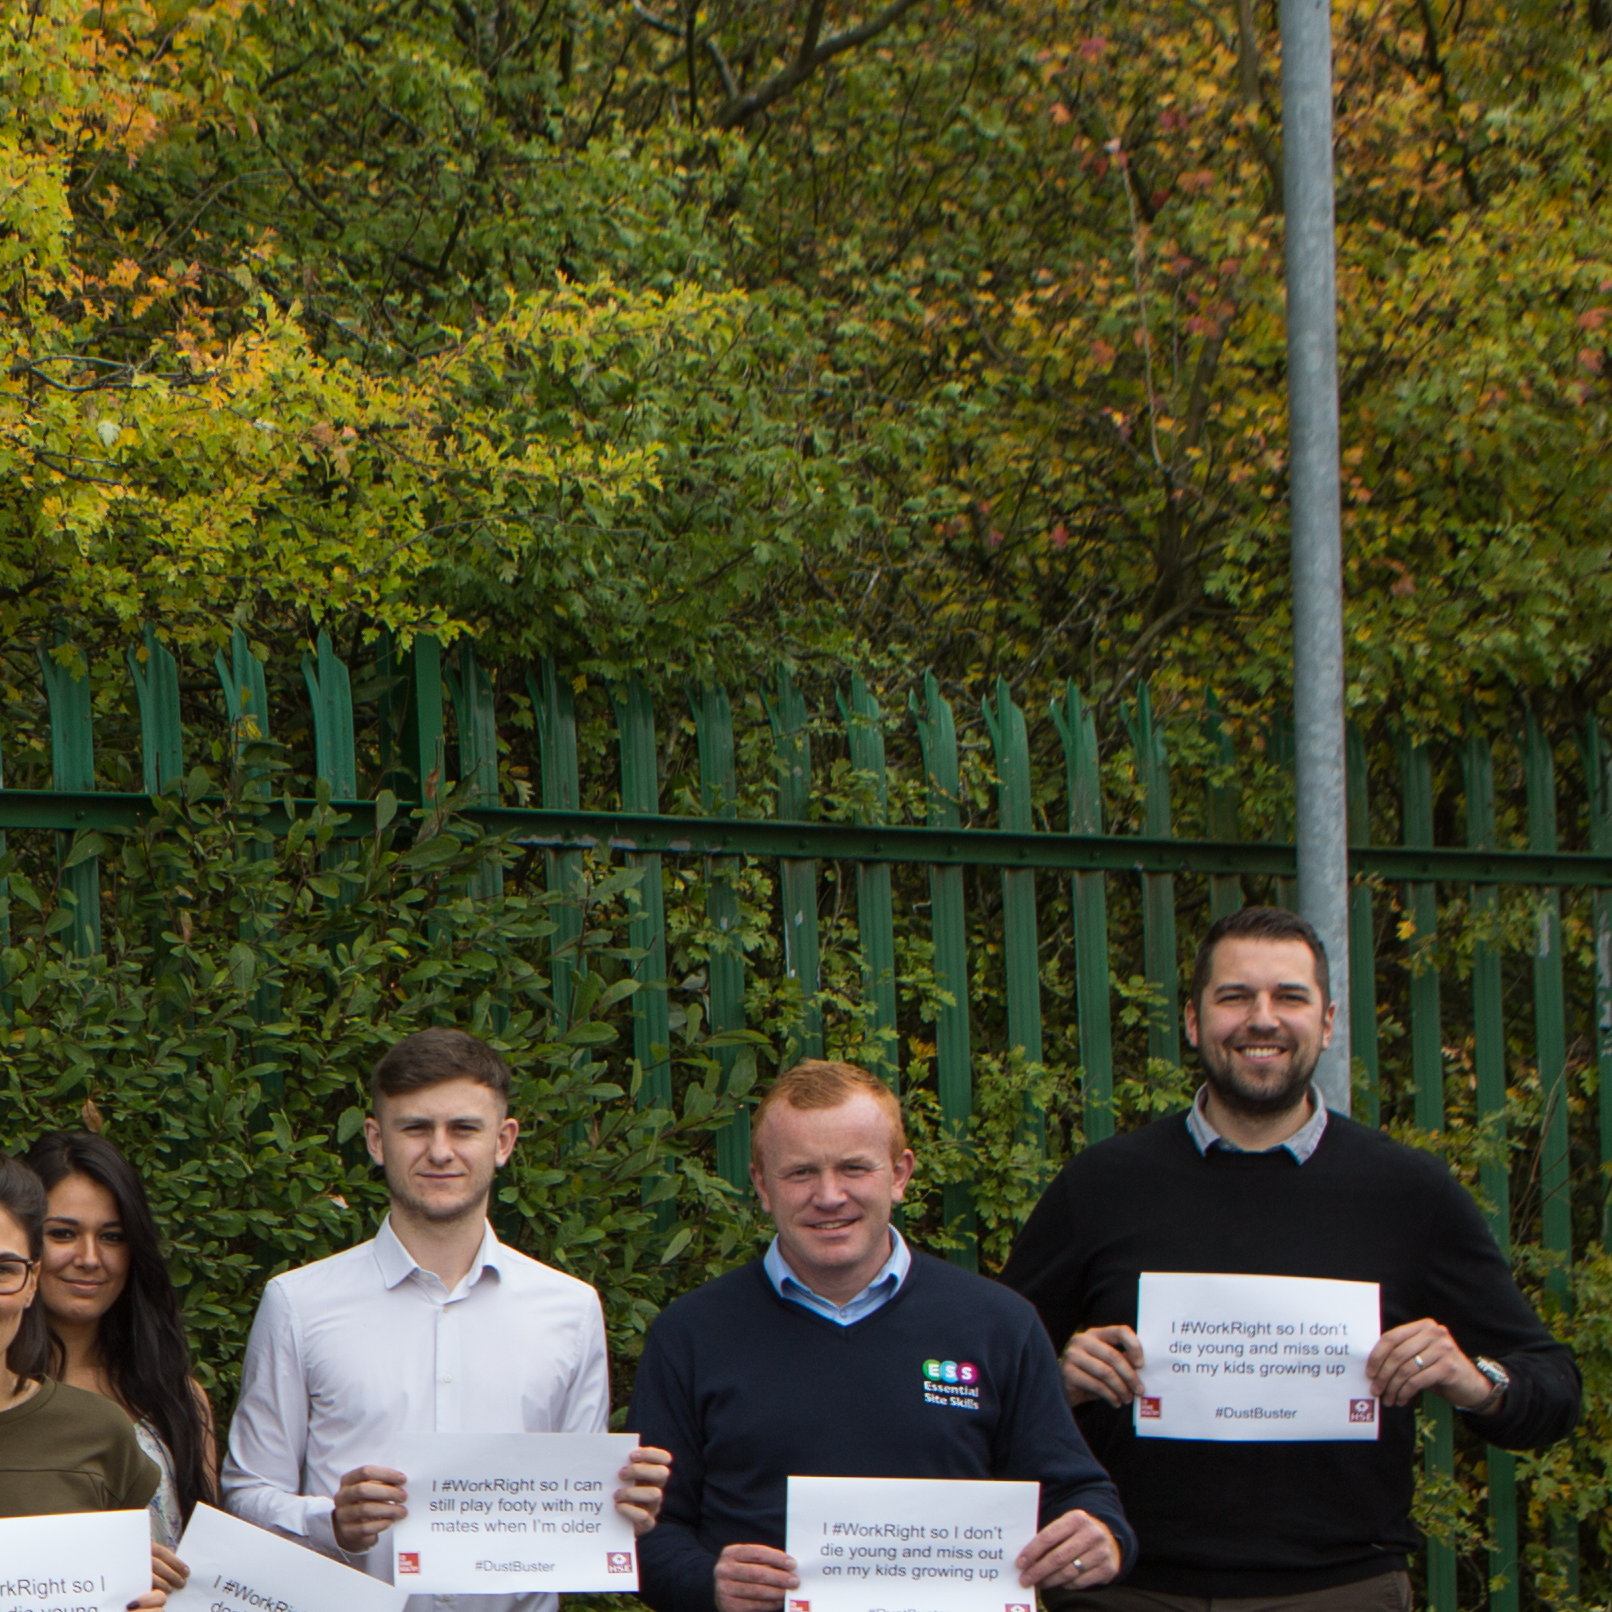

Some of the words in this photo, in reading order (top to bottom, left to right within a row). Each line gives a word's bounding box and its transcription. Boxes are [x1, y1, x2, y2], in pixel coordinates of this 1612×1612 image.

[1180, 1321, 1271, 1339] #WorkRight
[1276, 1325, 1295, 1335] so
[1169, 1341, 1192, 1354] die
[1197, 1344, 1244, 1358] young
[1249, 1341, 1278, 1355] and
[1283, 1342, 1320, 1356] miss
[1324, 1343, 1350, 1358] out
[924, 1381, 979, 1397] Essential
[924, 1392, 948, 1405] Site
[950, 1396, 979, 1410] Skills
[1215, 1407, 1297, 1419] #DustBuster
[441, 1478, 535, 1495] #WorkRight
[539, 1481, 559, 1491] so
[573, 1481, 603, 1492] can
[429, 1498, 455, 1512] still
[460, 1499, 493, 1515] play
[498, 1497, 537, 1515] footy
[542, 1499, 574, 1512] with
[579, 1501, 603, 1516] my
[431, 1520, 479, 1533] mates
[484, 1519, 527, 1533] when
[561, 1519, 602, 1534] older
[832, 1522, 925, 1541] #WorkRight
[930, 1528, 949, 1539] so
[475, 1560, 555, 1572] #DustBuster
[72, 1580, 94, 1593] so
